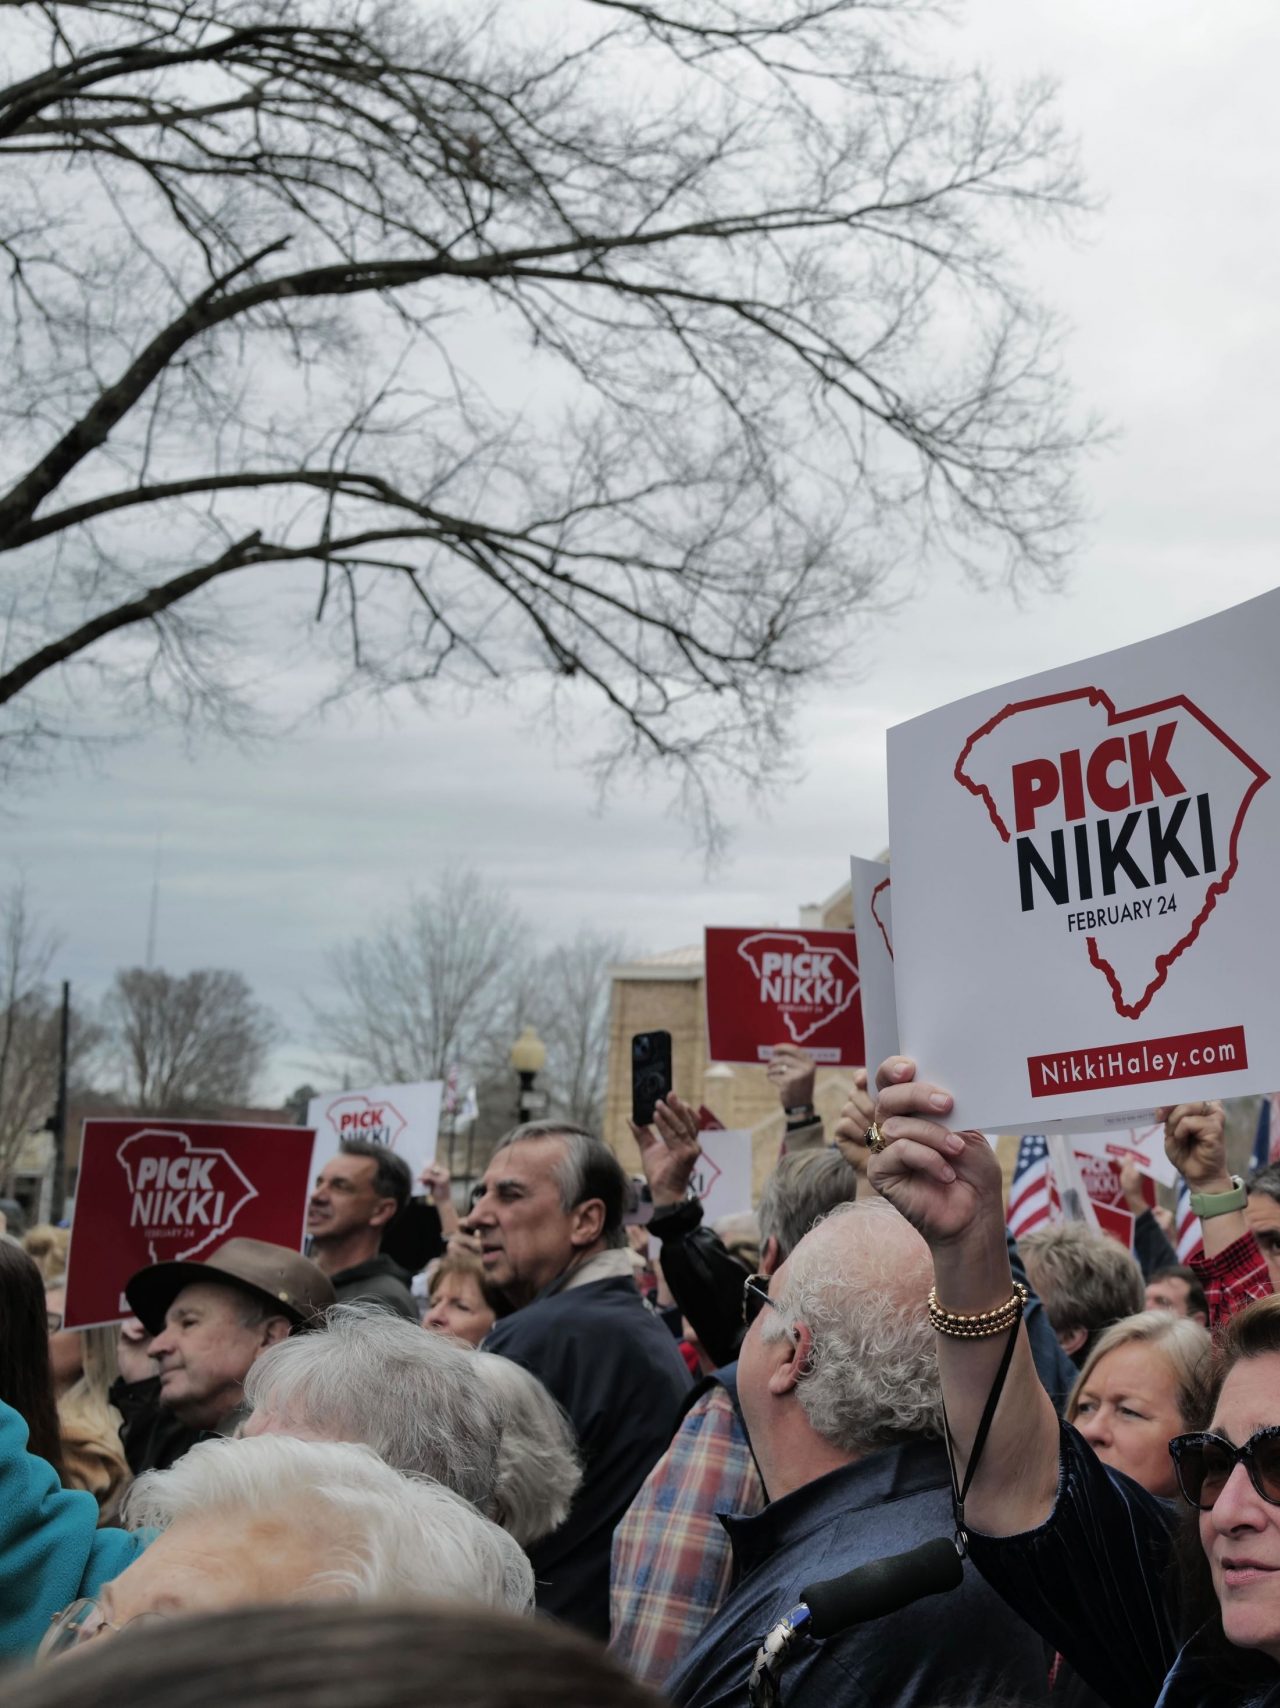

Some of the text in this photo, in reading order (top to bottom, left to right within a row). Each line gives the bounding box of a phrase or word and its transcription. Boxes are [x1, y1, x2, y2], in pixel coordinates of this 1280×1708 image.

[1012, 720, 1187, 833] PICK
[1016, 792, 1216, 912] NIKKI
[1067, 893, 1177, 932] FEBRUARY 24
[762, 952, 834, 979] PICK
[761, 976, 843, 1005] NIKKI
[1040, 1040, 1236, 1086] NikkiHaley.com
[341, 1109, 384, 1130] PICK
[136, 1157, 217, 1190] PICK
[130, 1190, 225, 1227] NIKKI
